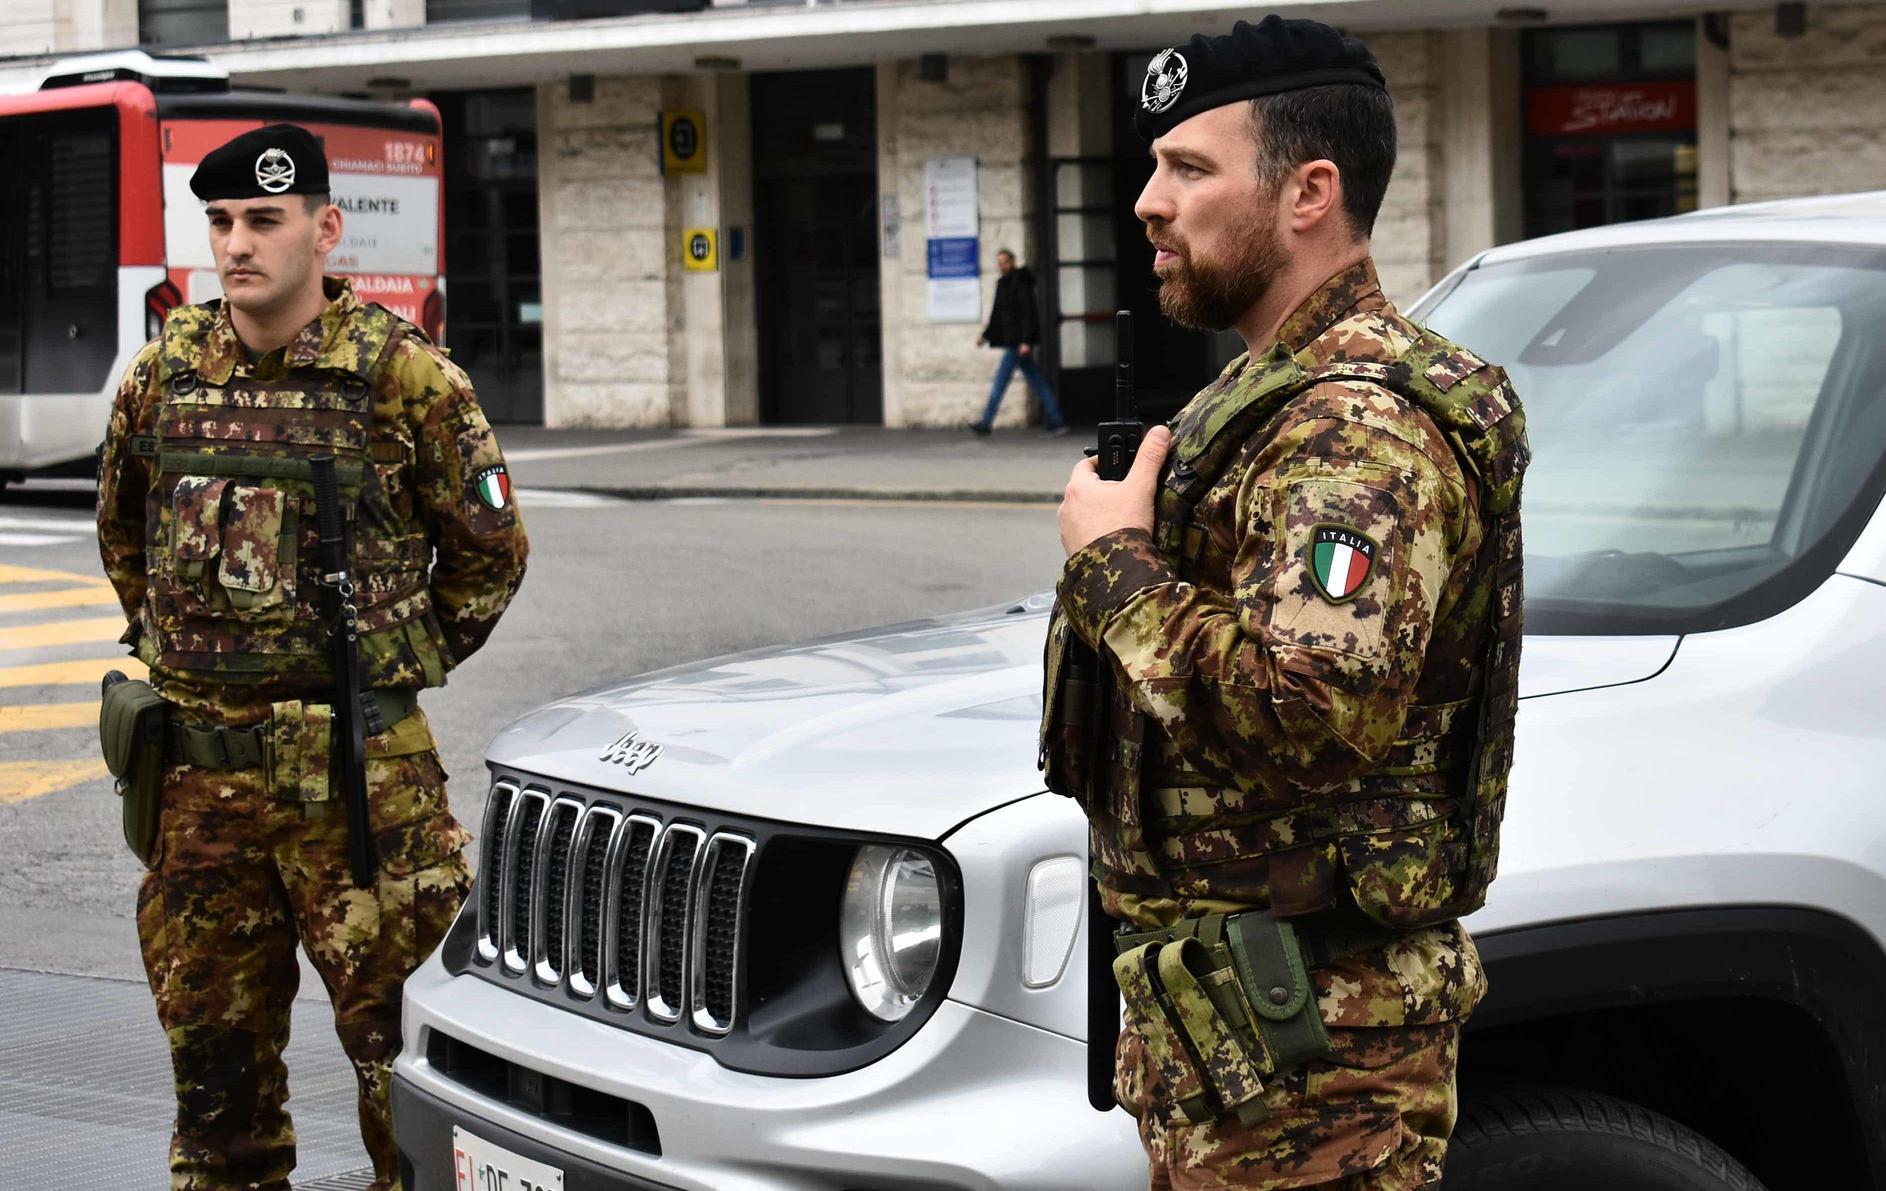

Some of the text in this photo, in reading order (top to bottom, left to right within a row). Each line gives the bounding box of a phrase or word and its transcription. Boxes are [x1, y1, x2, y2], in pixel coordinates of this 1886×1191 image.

[384, 142, 425, 164] 1874
[386, 162, 423, 175] SUBITO
[478, 466, 505, 481] ITALIA
[1322, 531, 1371, 555] ITALIA
[598, 731, 665, 776] Jeep
